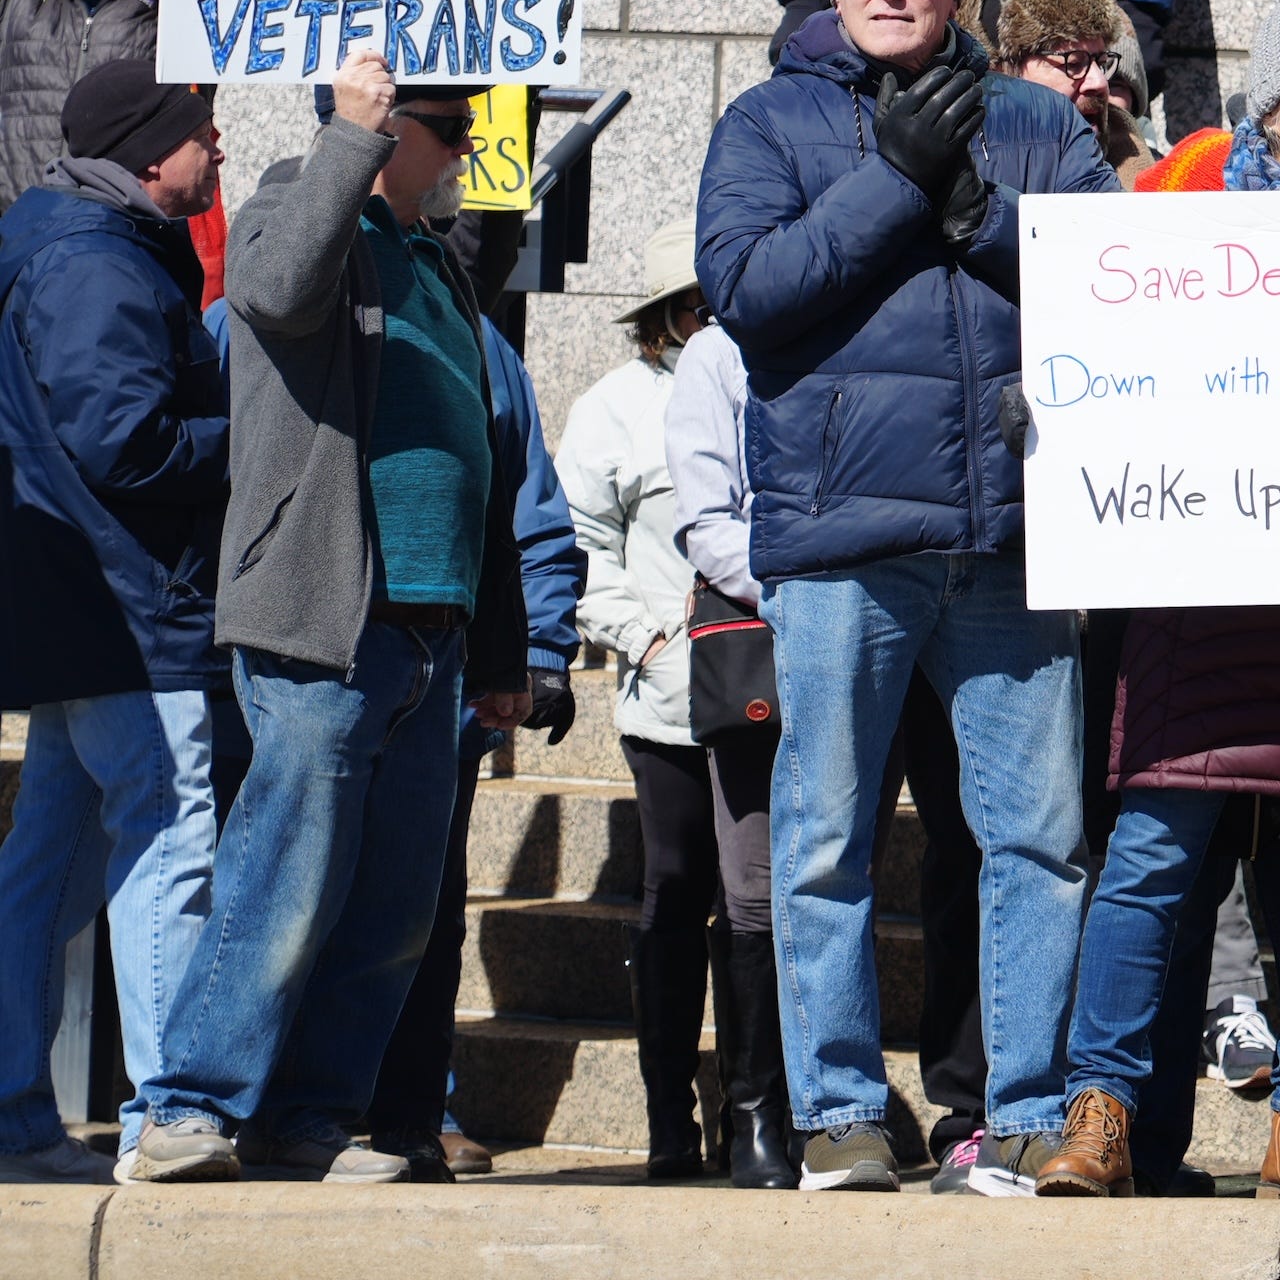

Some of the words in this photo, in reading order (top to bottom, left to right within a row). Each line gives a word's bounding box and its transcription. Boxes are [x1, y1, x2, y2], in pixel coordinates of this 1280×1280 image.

[1091, 244, 1204, 303] Save
[1035, 354, 1156, 408] Down
[1204, 356, 1269, 396] with
[1081, 462, 1207, 525] Wake
